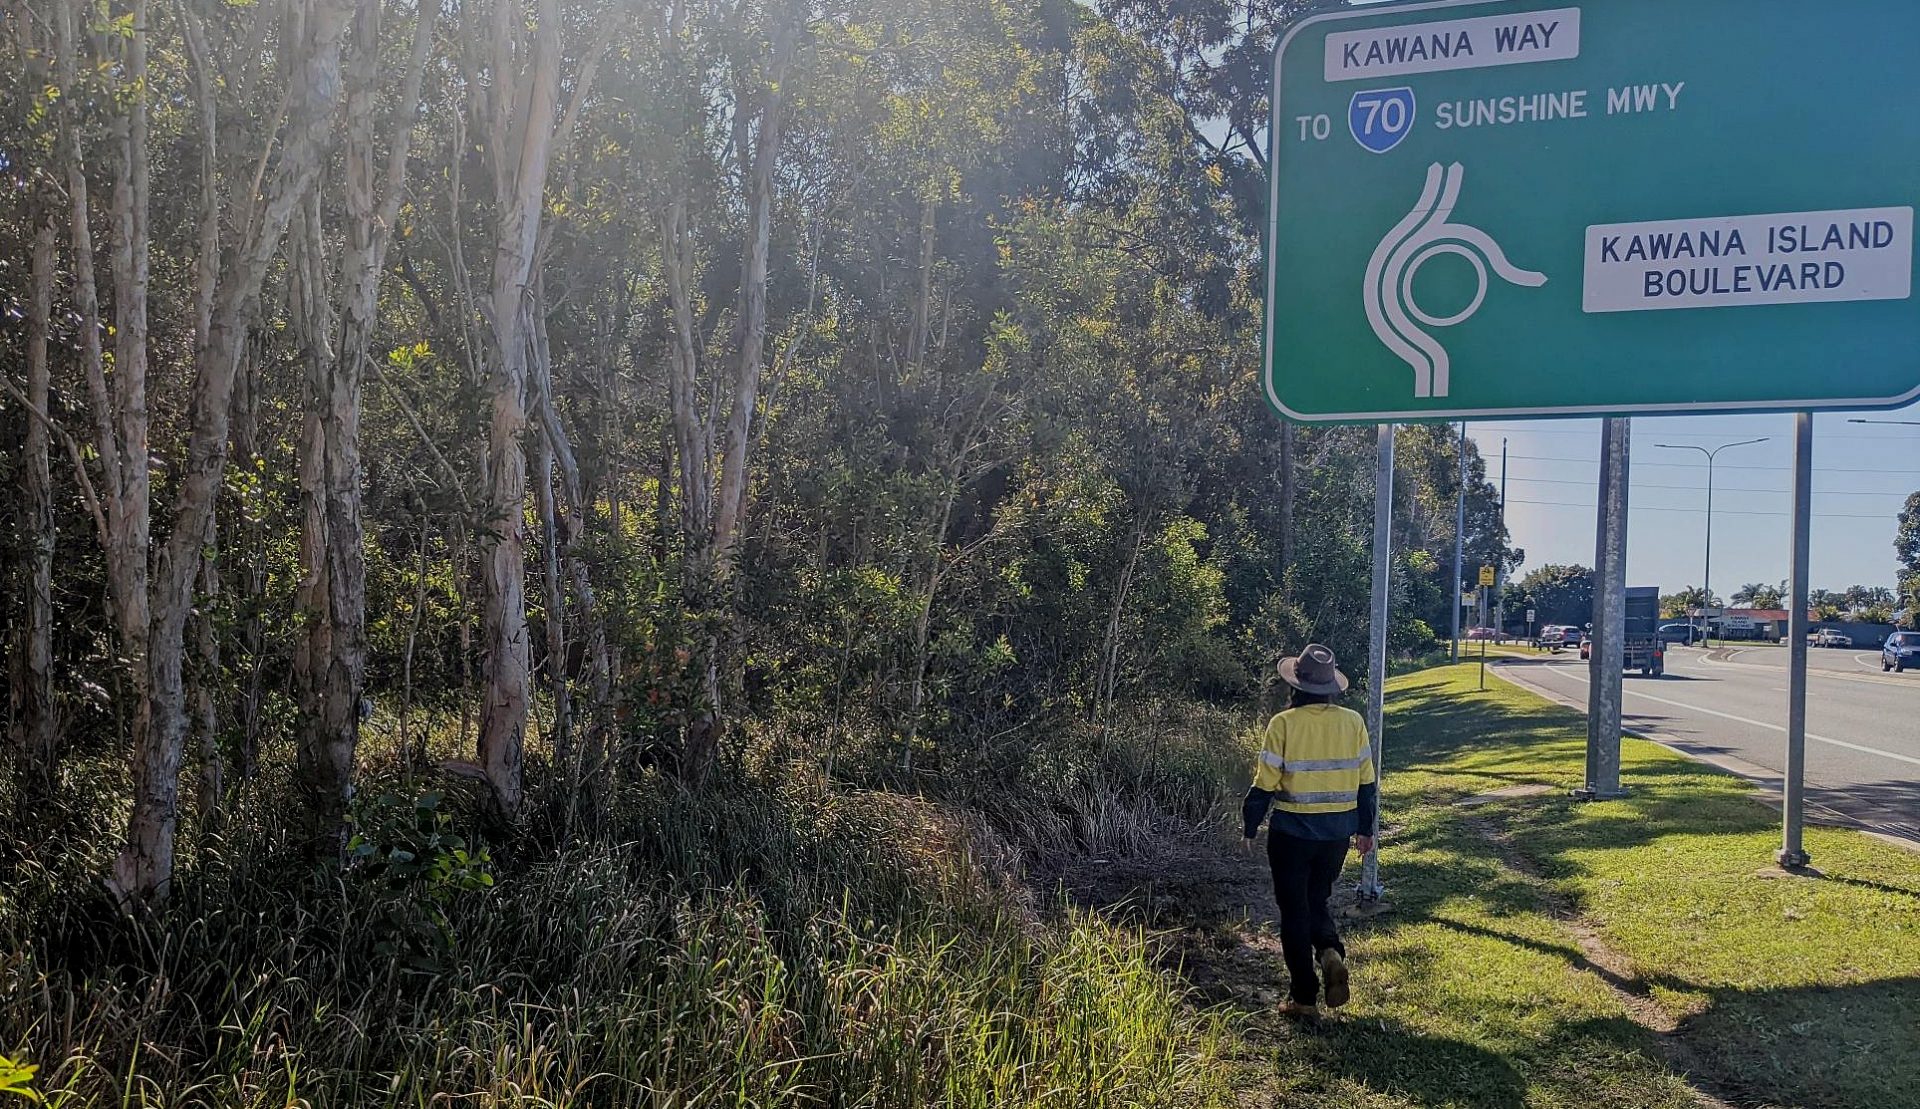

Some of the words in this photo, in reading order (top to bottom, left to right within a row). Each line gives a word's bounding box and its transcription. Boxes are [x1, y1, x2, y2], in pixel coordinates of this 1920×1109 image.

[1343, 31, 1474, 69] KAWANA
[1494, 22, 1560, 53] WAY
[1295, 113, 1331, 142] TO
[1358, 98, 1406, 135] 70
[1434, 91, 1588, 129] SUNSHINE
[1607, 81, 1685, 115] MWY
[1601, 229, 1747, 263] KAWANA
[1768, 221, 1894, 254] ISLAND
[1644, 261, 1845, 298] BOULEVARD
